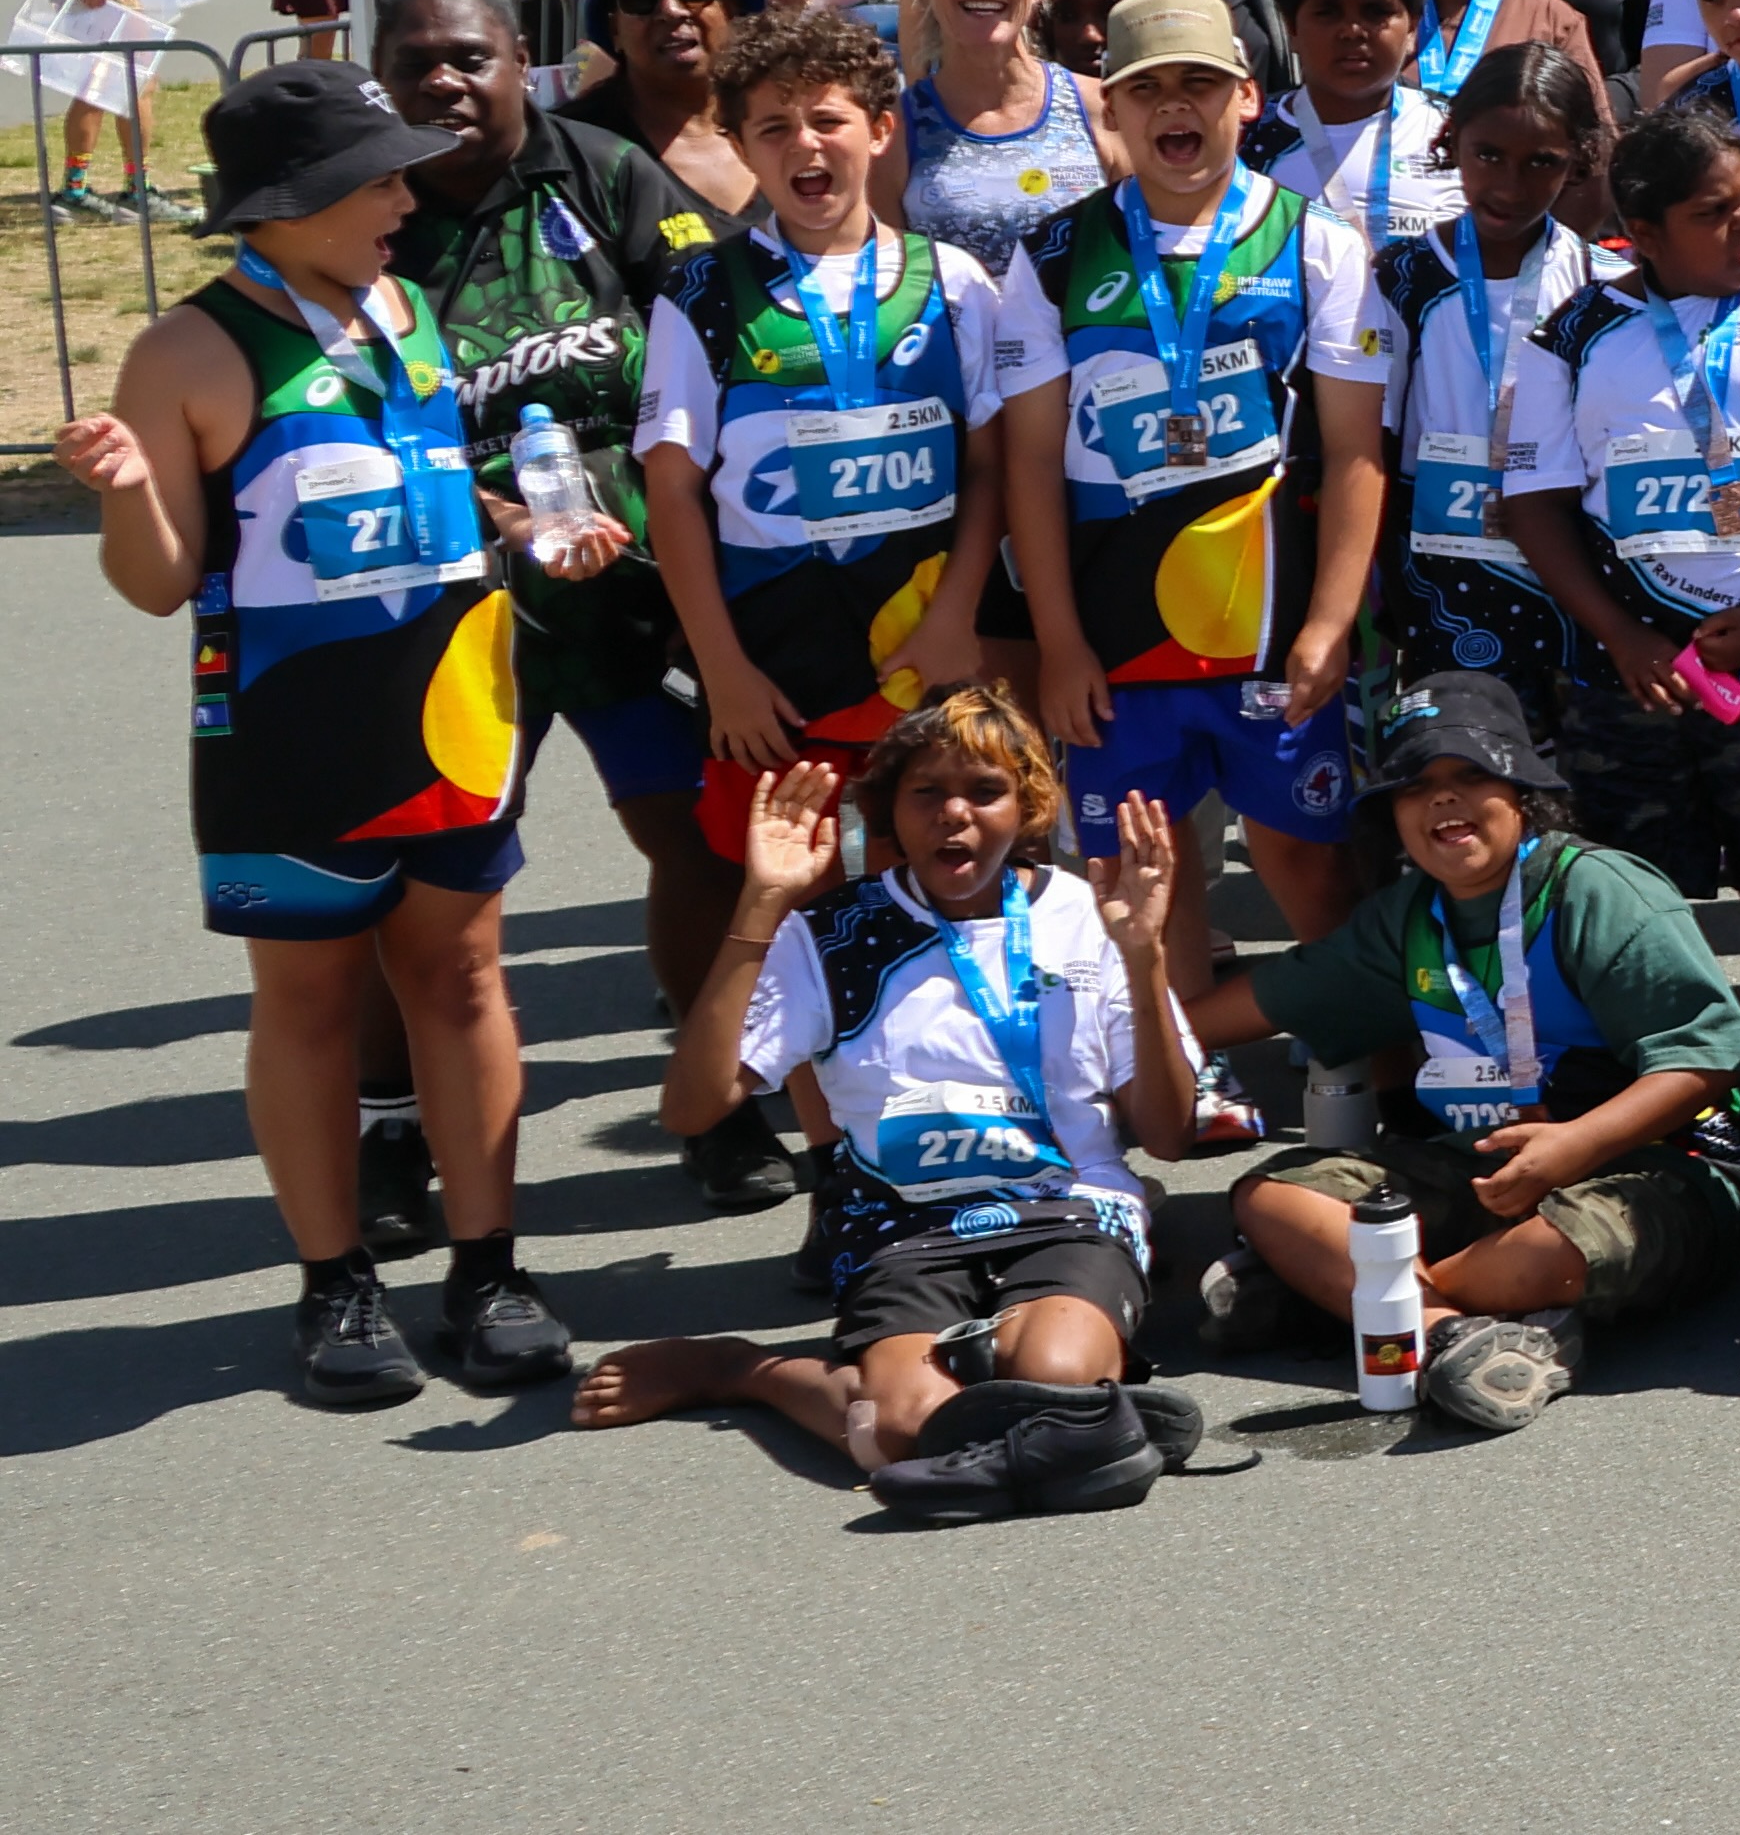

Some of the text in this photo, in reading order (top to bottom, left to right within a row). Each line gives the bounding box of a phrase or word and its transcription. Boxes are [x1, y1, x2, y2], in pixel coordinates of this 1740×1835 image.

[1237, 276, 1292, 289] IMF RAW
[1197, 348, 1251, 378] .5KM
[888, 396, 943, 431] 2.5KM
[1133, 393, 1243, 454] 202
[828, 446, 936, 498] 2704
[1445, 480, 1489, 521] 27
[1633, 474, 1713, 518] 272
[348, 507, 402, 553] 27
[1651, 559, 1734, 607] Ray Landers
[917, 1125, 1036, 1168] 2748
